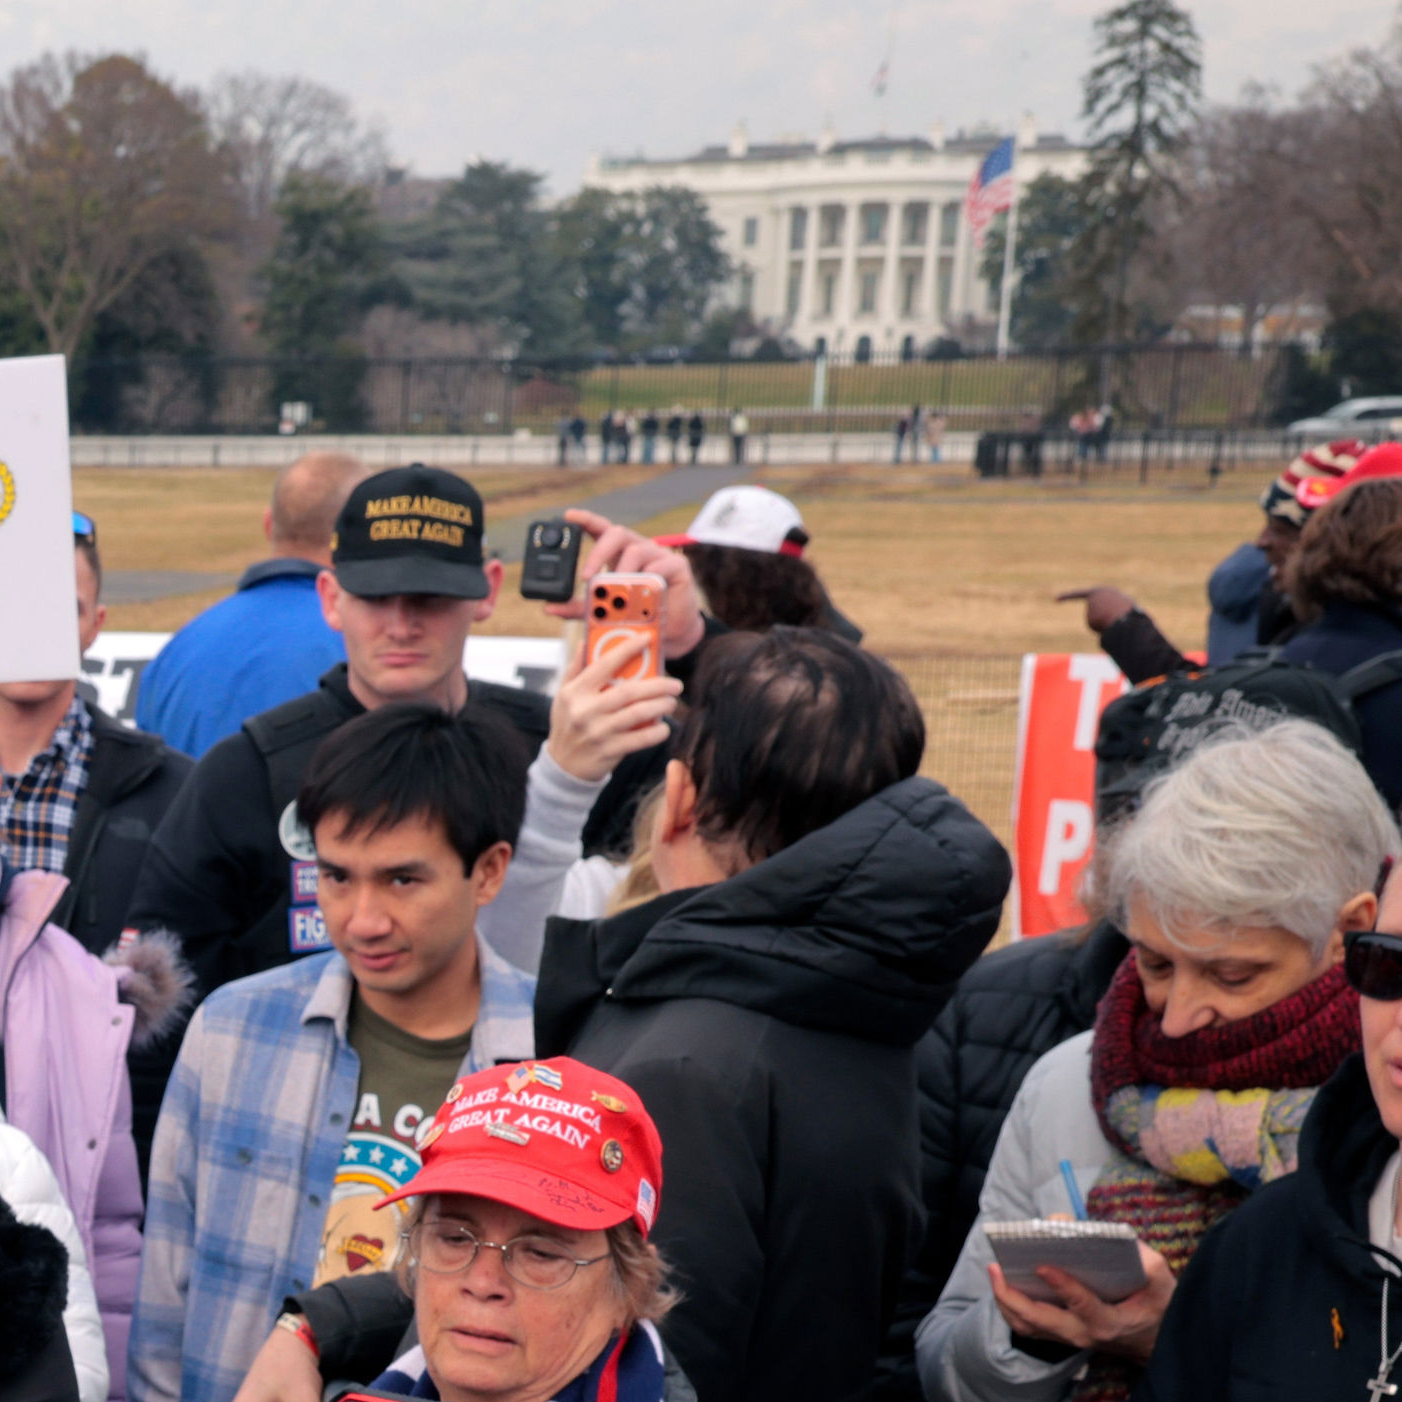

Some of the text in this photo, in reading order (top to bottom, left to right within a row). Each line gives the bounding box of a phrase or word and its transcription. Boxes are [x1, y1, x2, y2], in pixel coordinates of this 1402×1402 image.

[369, 519, 419, 541] GREAT
[448, 1108, 511, 1134] GREAT
[513, 1112, 591, 1150] AGAIN
[450, 1087, 499, 1116] MAKE
[500, 1090, 602, 1134] AMERICA
